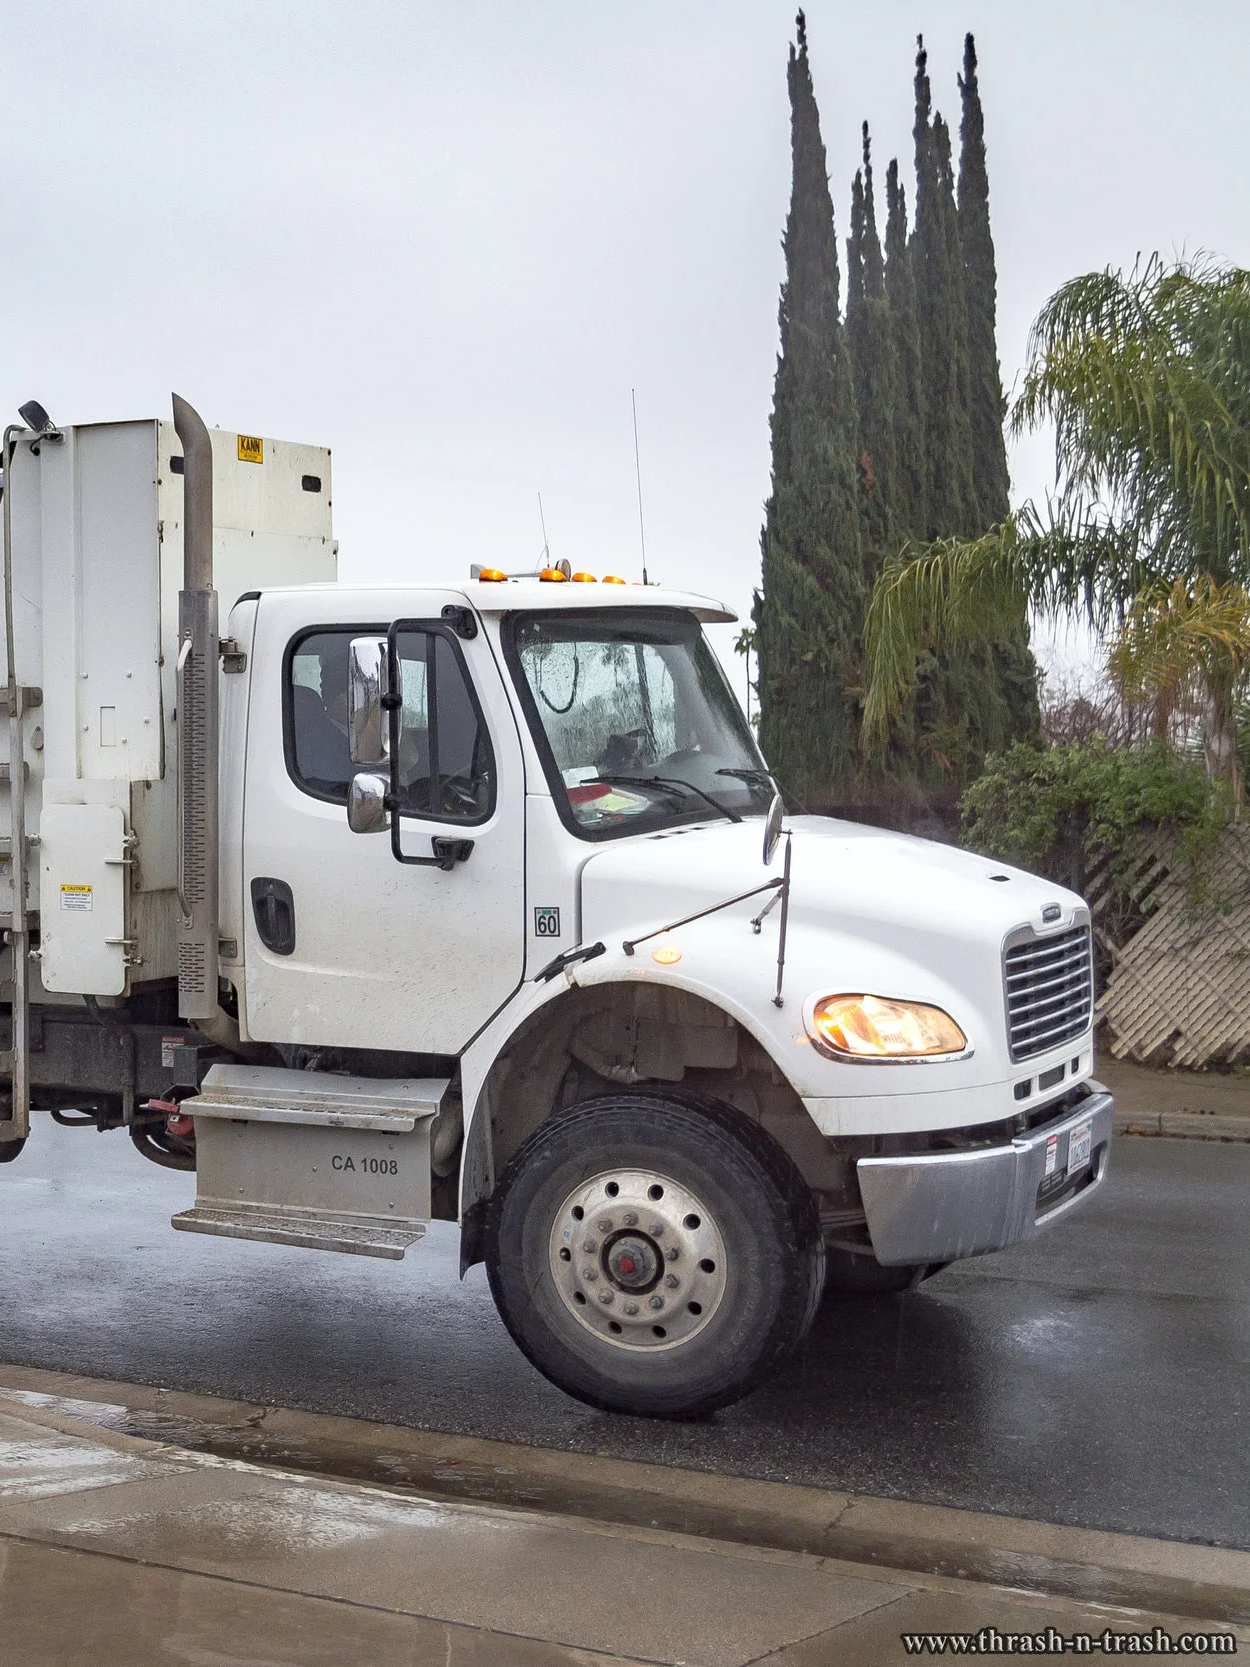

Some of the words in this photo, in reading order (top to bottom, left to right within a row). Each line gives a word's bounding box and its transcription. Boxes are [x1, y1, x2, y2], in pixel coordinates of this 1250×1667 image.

[240, 437, 261, 453] KANN
[537, 915, 557, 934] 60
[331, 1155, 356, 1172] CA
[360, 1157, 398, 1175] 1008
